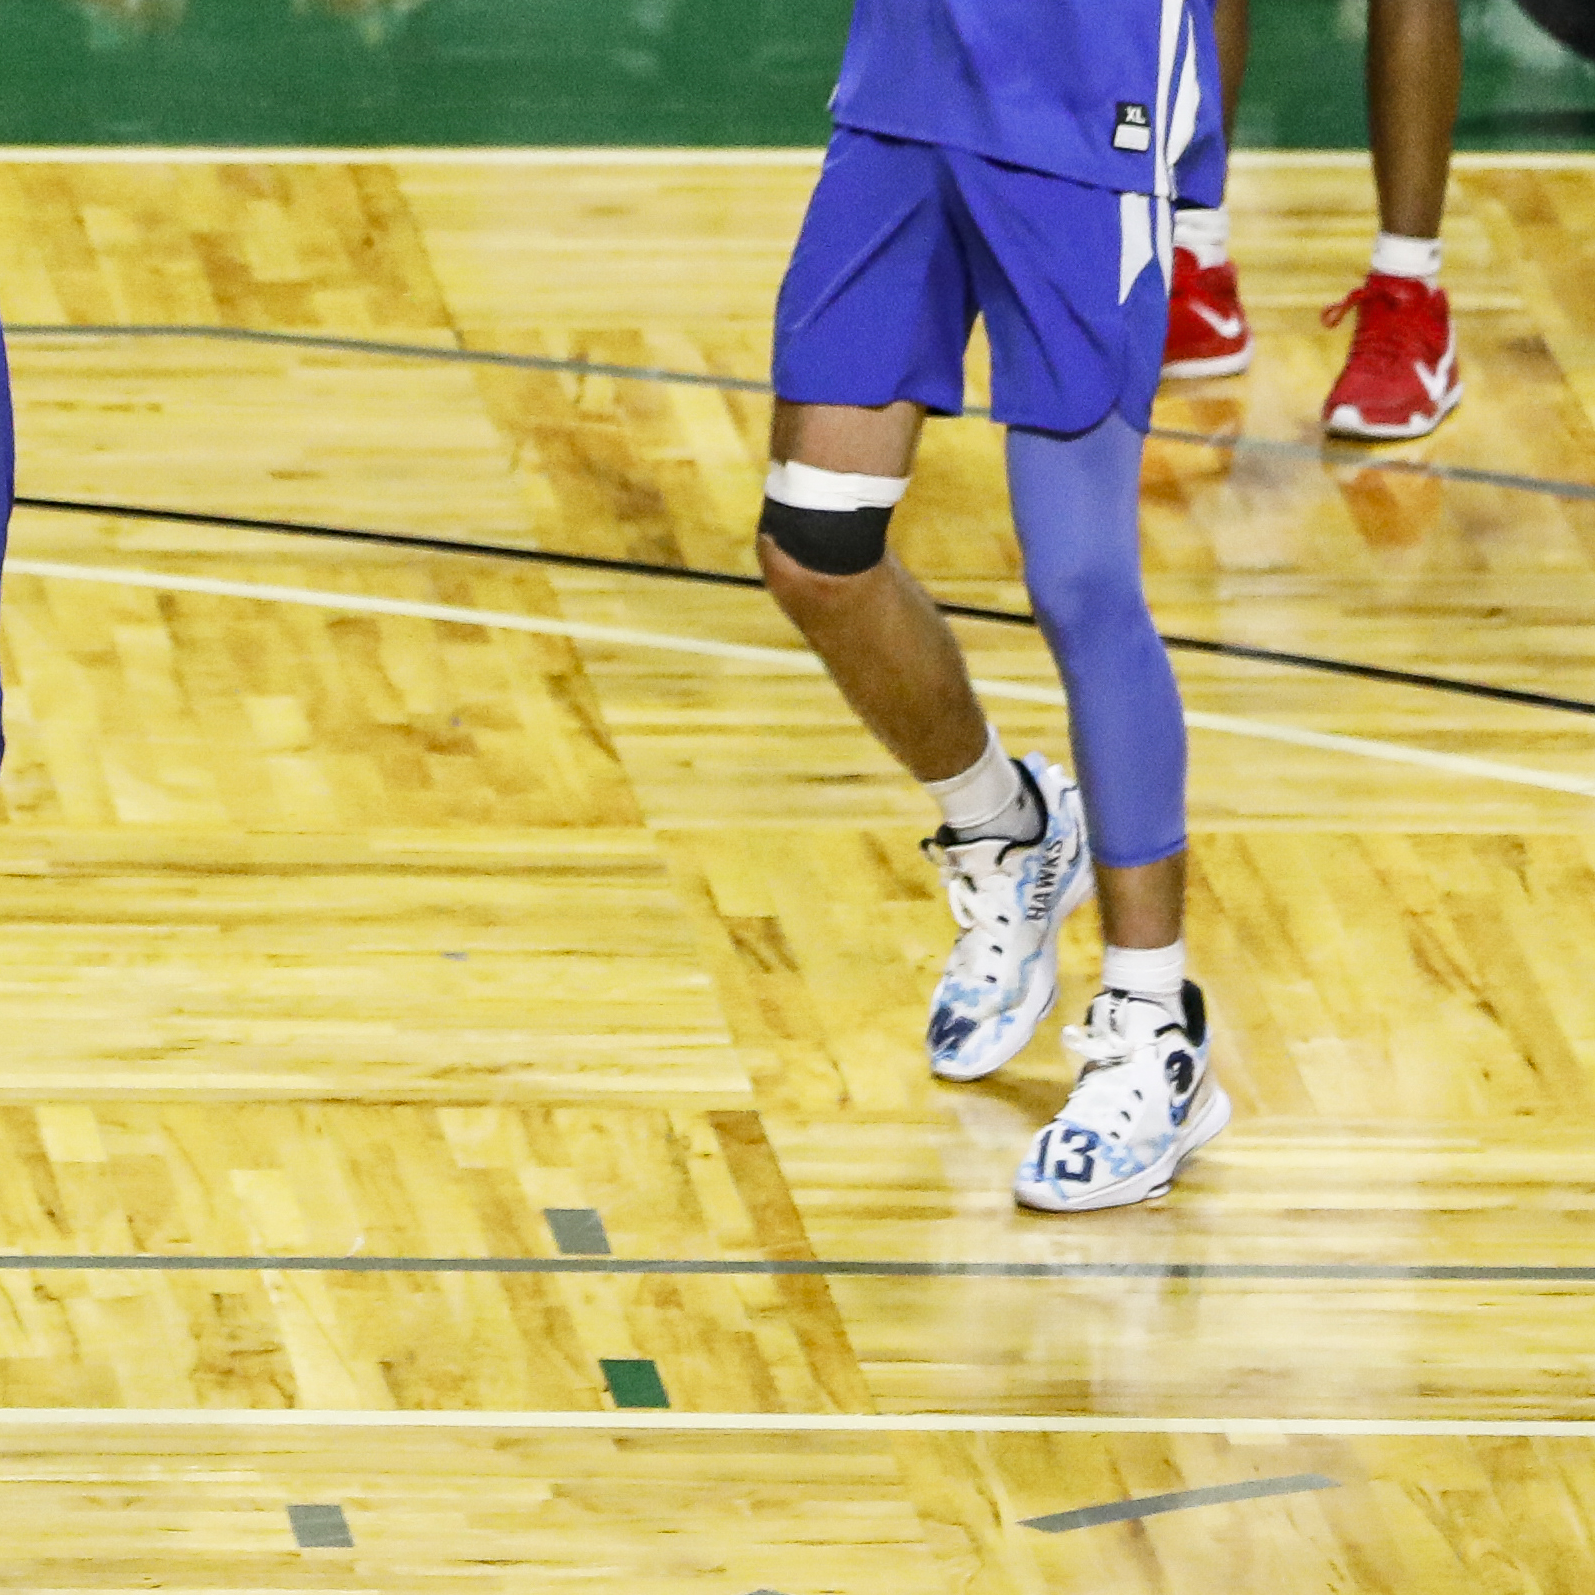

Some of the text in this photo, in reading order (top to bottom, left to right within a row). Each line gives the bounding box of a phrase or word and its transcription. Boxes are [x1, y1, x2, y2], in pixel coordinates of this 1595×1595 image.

[1125, 105, 1146, 125] XL
[1025, 840, 1064, 921] HAWKS
[1034, 1127, 1100, 1184] 13
